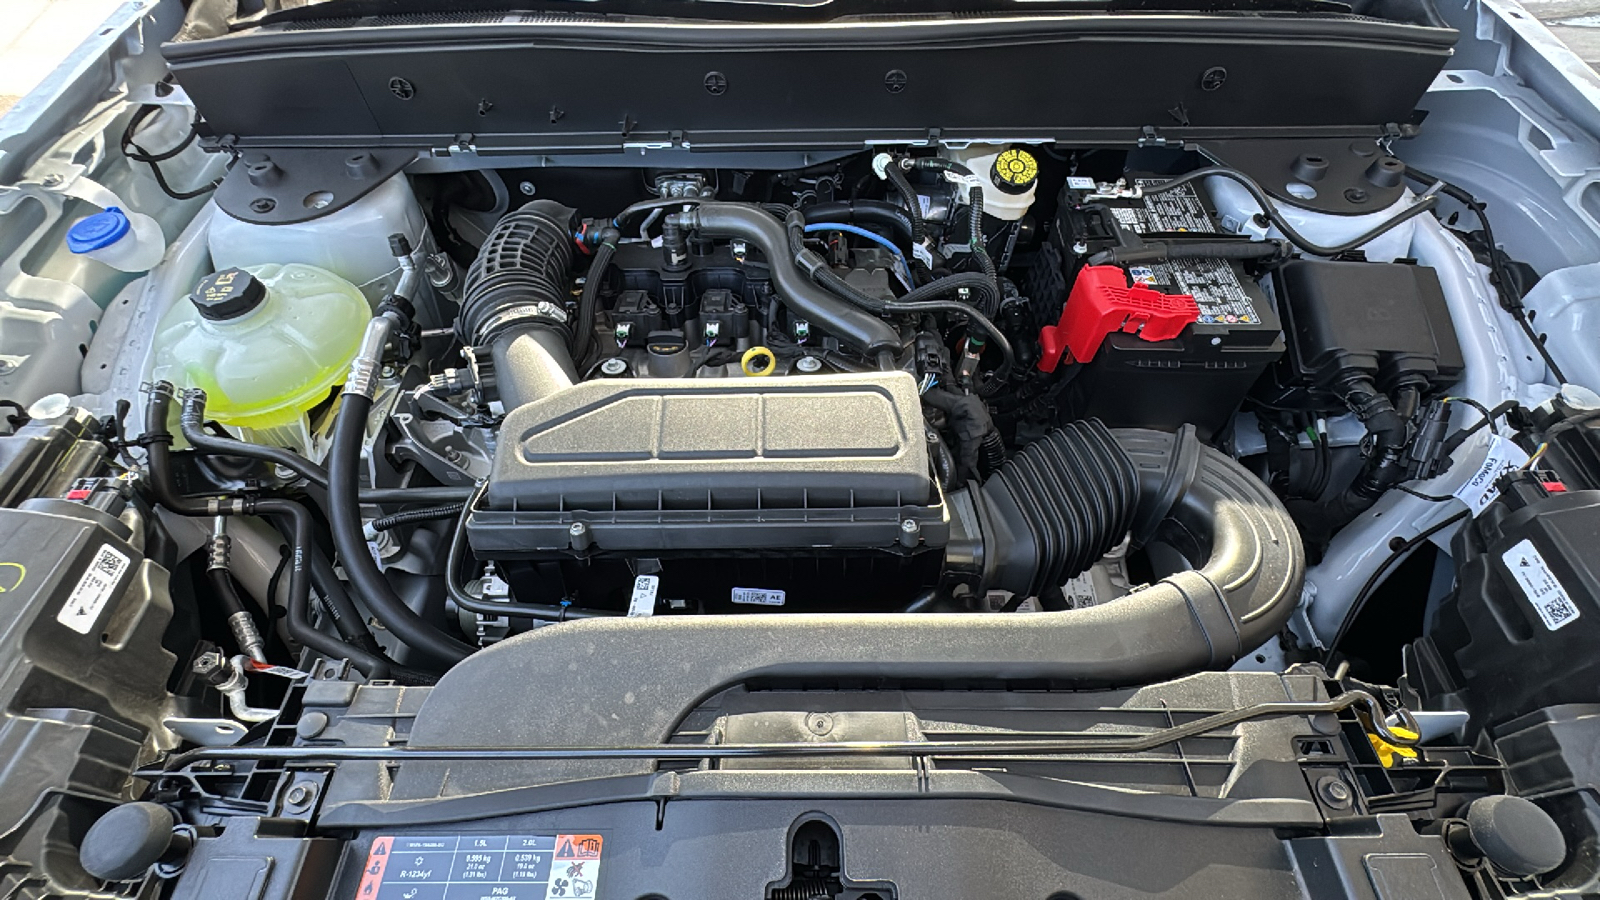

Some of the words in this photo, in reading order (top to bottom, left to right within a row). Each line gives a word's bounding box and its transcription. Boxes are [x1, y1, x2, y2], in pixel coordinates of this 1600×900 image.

[474, 839, 488, 847] 1.5L
[483, 854, 492, 864] kg
[533, 854, 541, 863] kg
[399, 870, 432, 880] R-1234yf
[492, 887, 509, 895] PAG
